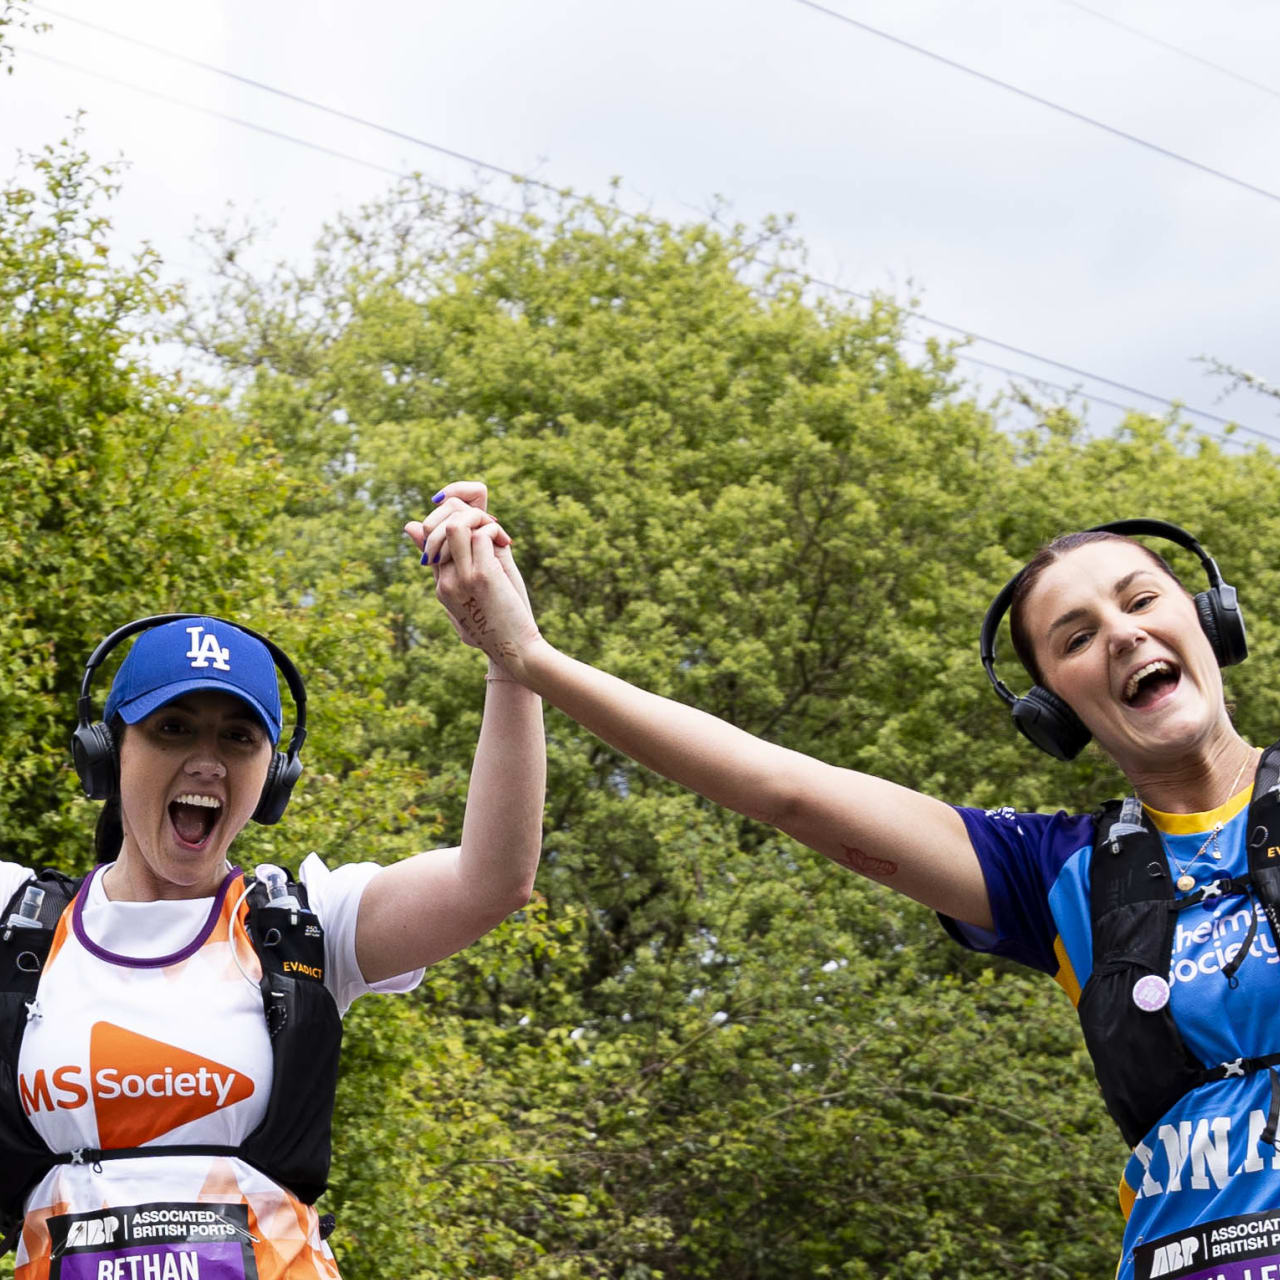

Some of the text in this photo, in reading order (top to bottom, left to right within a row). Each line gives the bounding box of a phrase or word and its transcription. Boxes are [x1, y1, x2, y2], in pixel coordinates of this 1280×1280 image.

[185, 626, 231, 671] LA
[283, 960, 322, 979] EVADICT
[19, 1065, 236, 1117] MS Society
[131, 1210, 216, 1226] ASSOCIATED
[132, 1223, 236, 1239] BRITISH PORTS
[1149, 1236, 1200, 1279] ABP
[1212, 1235, 1269, 1258] BRITISH
